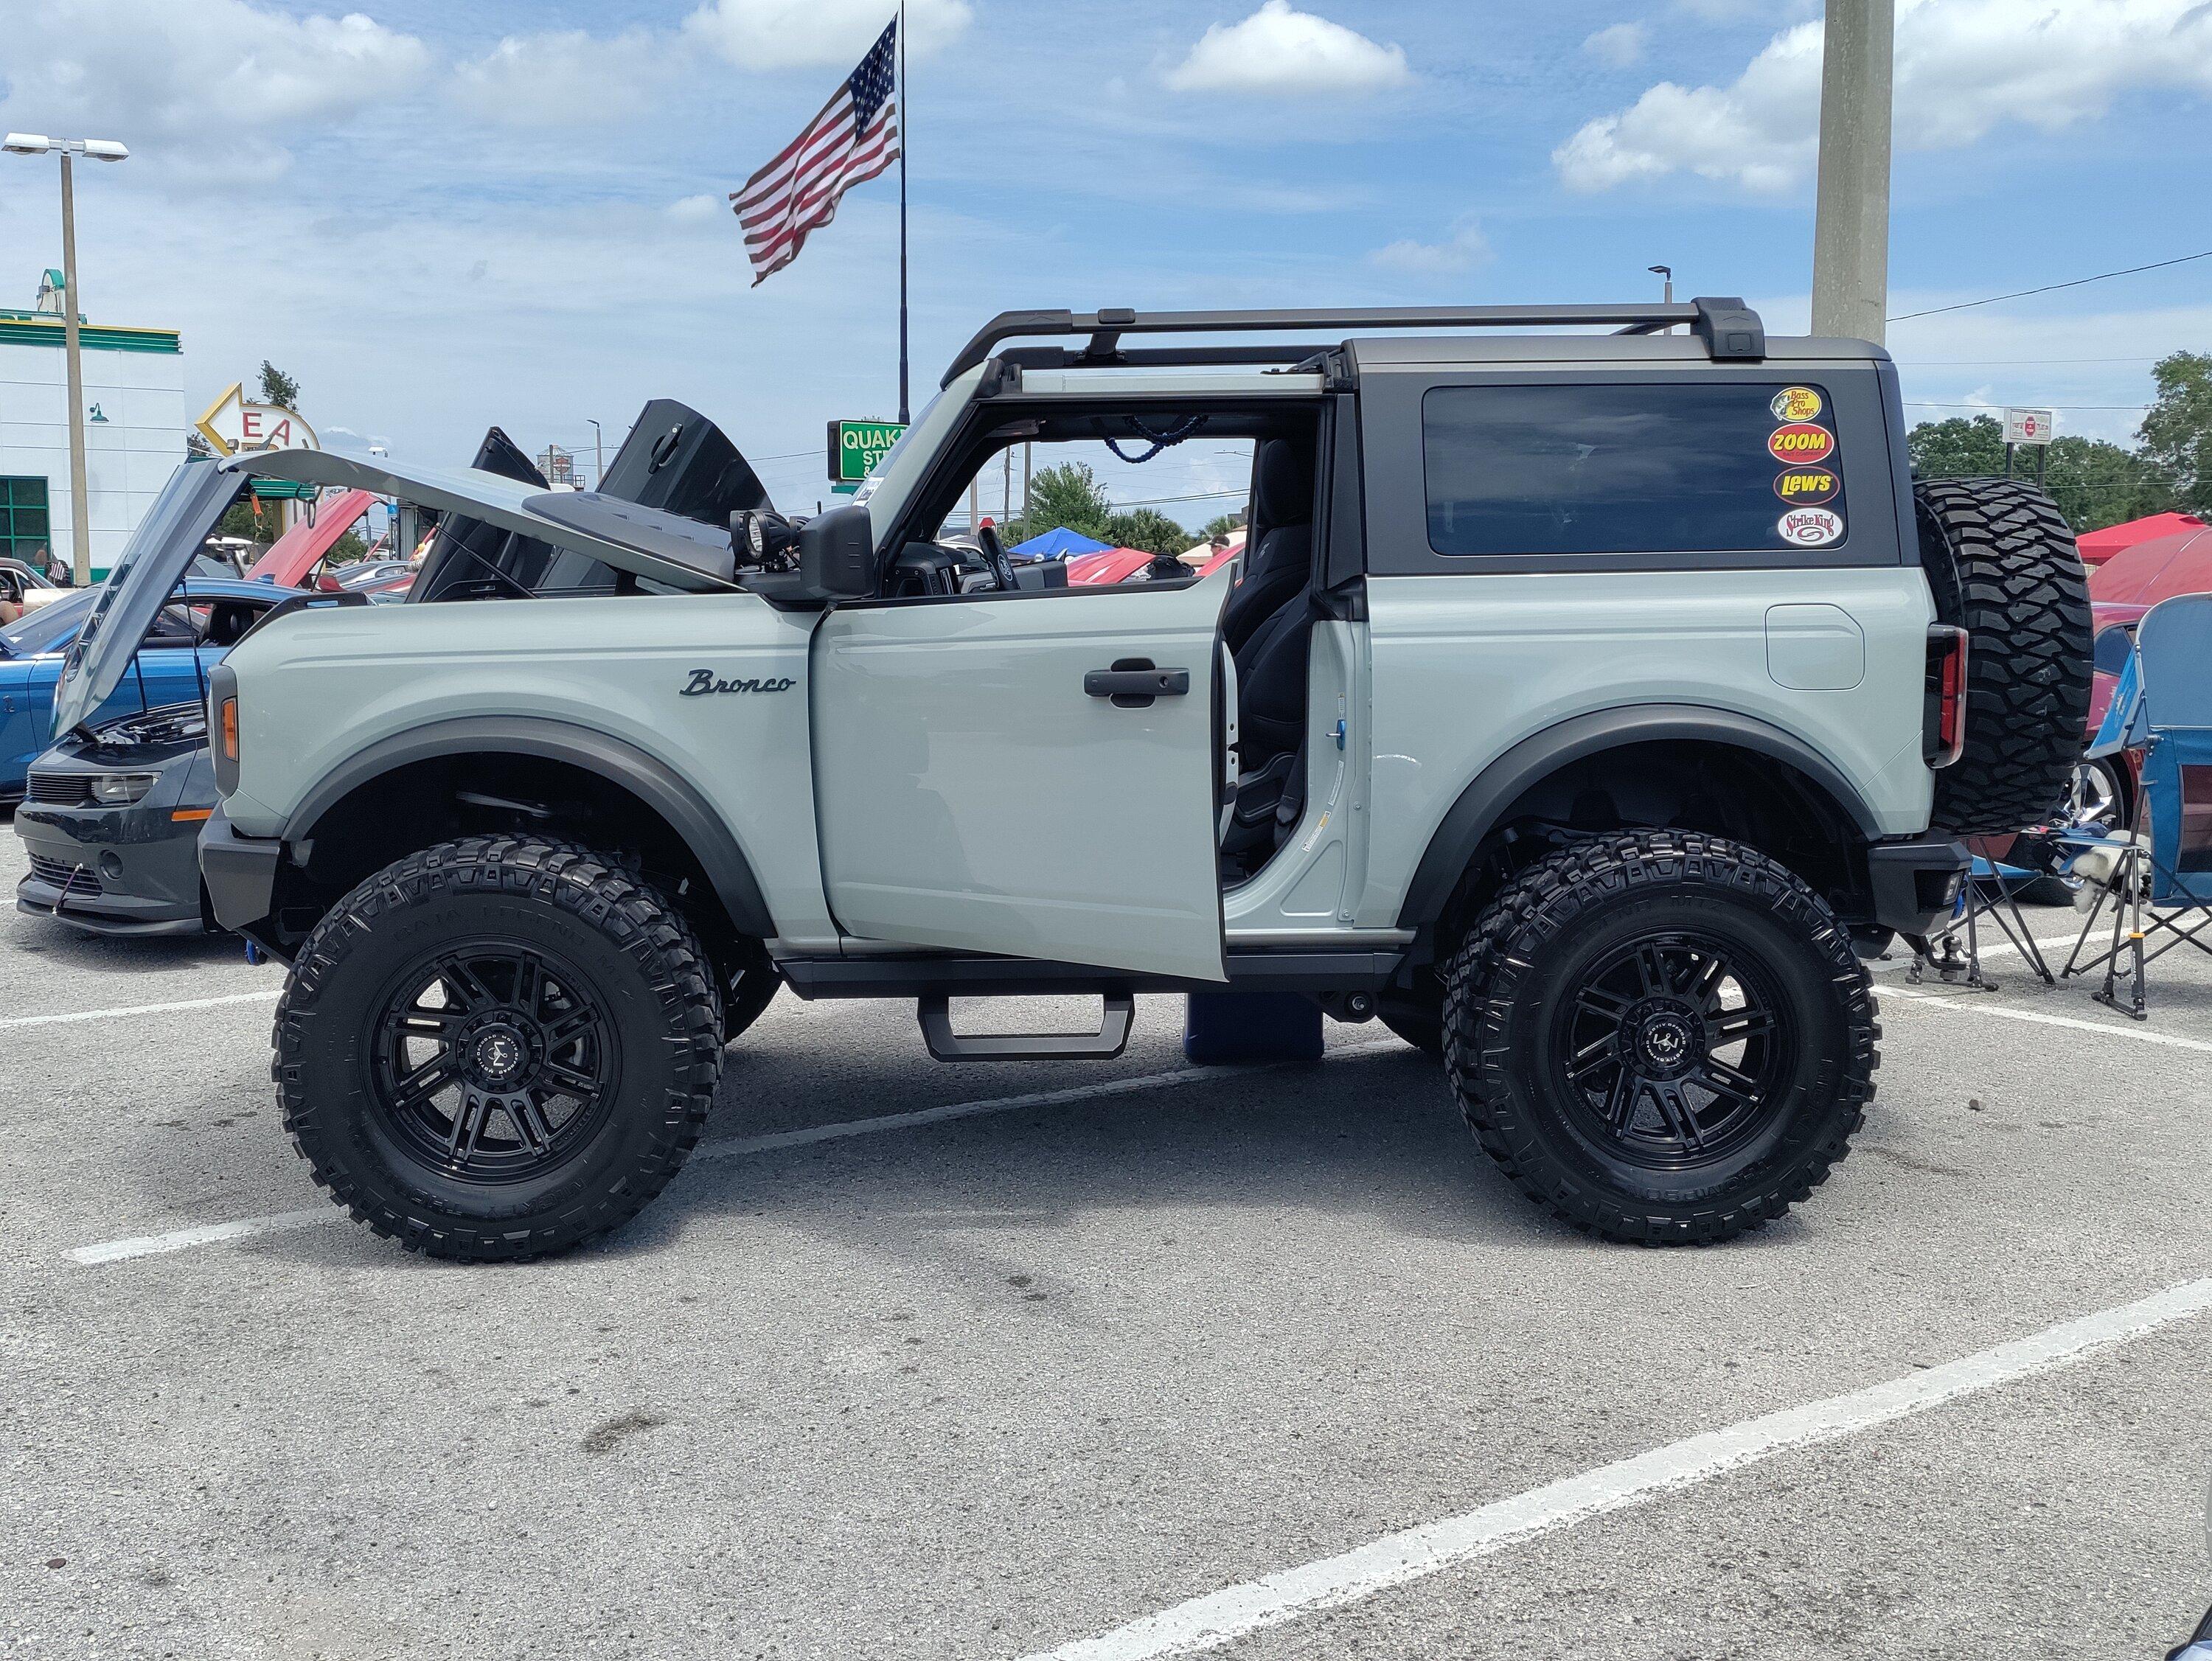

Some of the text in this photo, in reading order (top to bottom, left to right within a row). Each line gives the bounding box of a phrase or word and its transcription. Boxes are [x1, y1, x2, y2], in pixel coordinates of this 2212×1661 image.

[1790, 391, 1809, 399] Bass
[1792, 399, 1805, 407] Pro
[1792, 407, 1815, 417] Shops
[243, 411, 310, 449] EA
[843, 428, 905, 449] QUAK
[1773, 433, 1826, 450] ZOOM
[863, 450, 888, 465] ST
[1787, 514, 1834, 537] Strike King
[679, 669, 797, 696] Bronco
